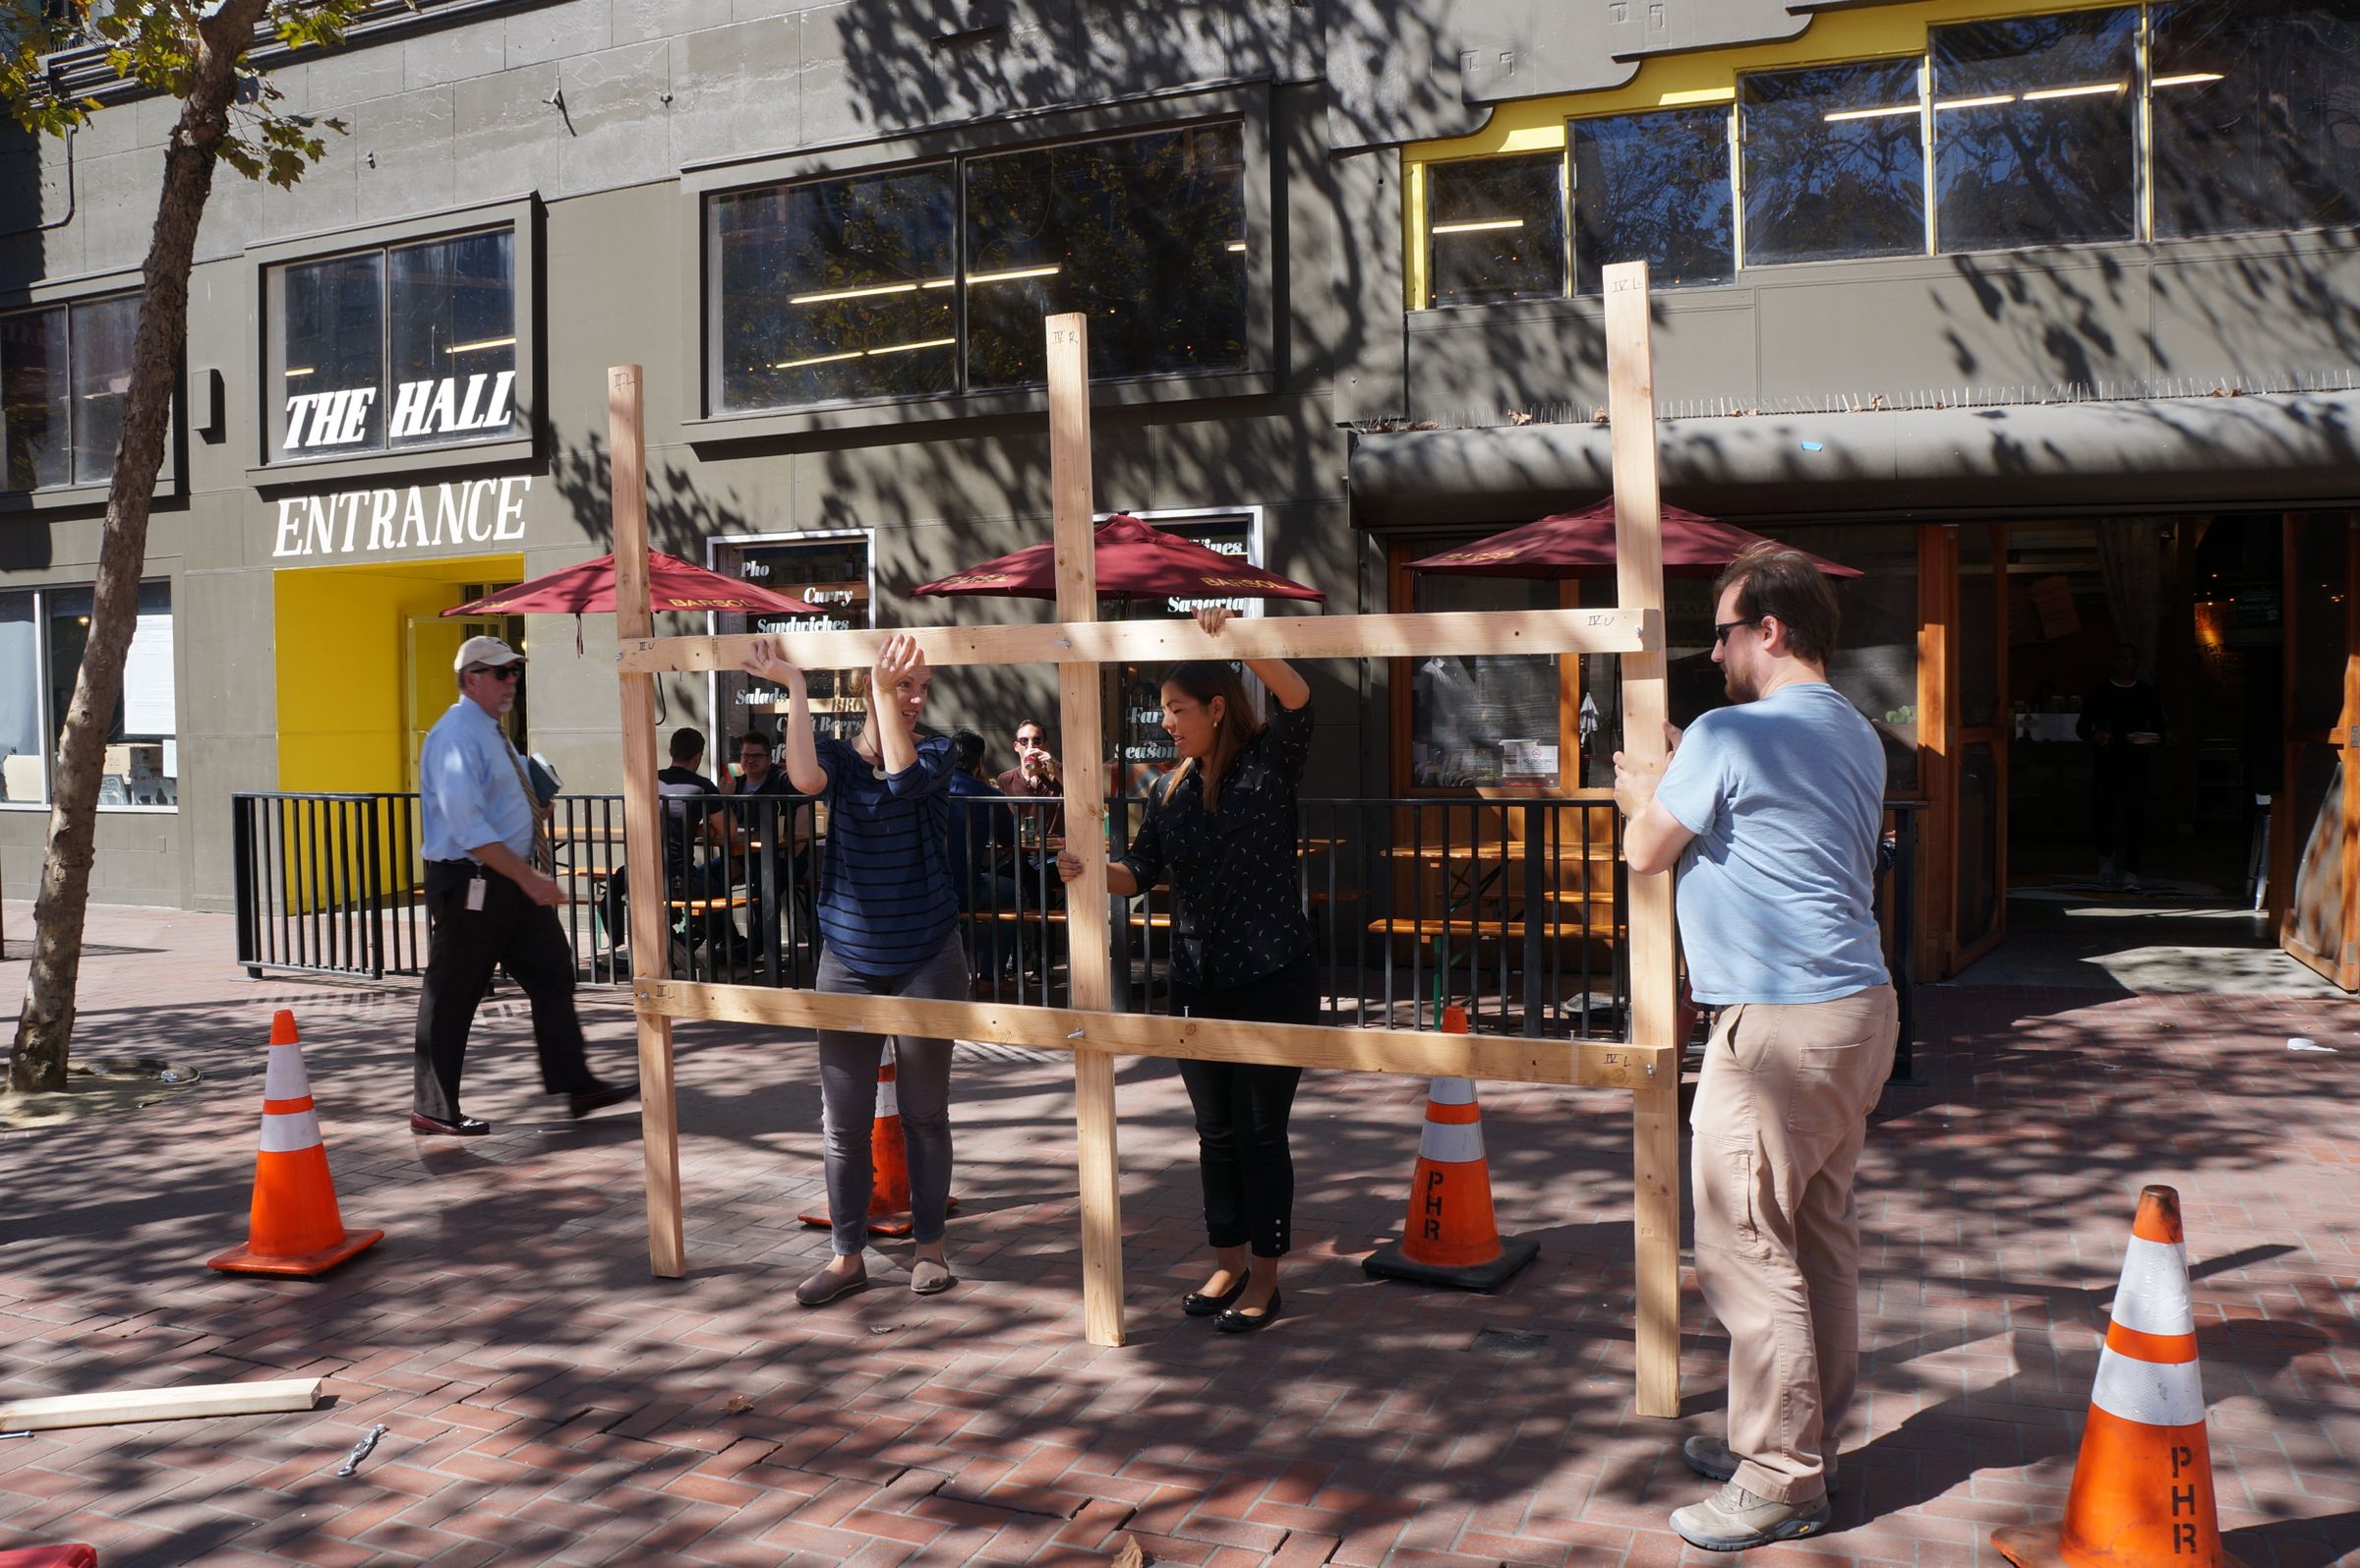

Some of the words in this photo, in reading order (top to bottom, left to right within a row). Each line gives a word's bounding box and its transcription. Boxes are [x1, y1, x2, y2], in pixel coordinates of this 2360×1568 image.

[283, 387, 376, 449] THE
[389, 371, 515, 437] HALL
[272, 476, 532, 556] ENTRANCE
[1189, 538, 1243, 555] ines
[740, 560, 770, 578] Pho
[1201, 577, 1289, 589] BARSOL
[669, 599, 757, 608] BARSOL
[803, 587, 854, 607] Curry
[757, 615, 850, 633] Sandwiches
[736, 688, 788, 705] Salads
[1130, 707, 1163, 724] Far
[820, 717, 864, 732] Beers
[1114, 742, 1178, 759] eason
[2171, 1446, 2197, 1554] PHR
